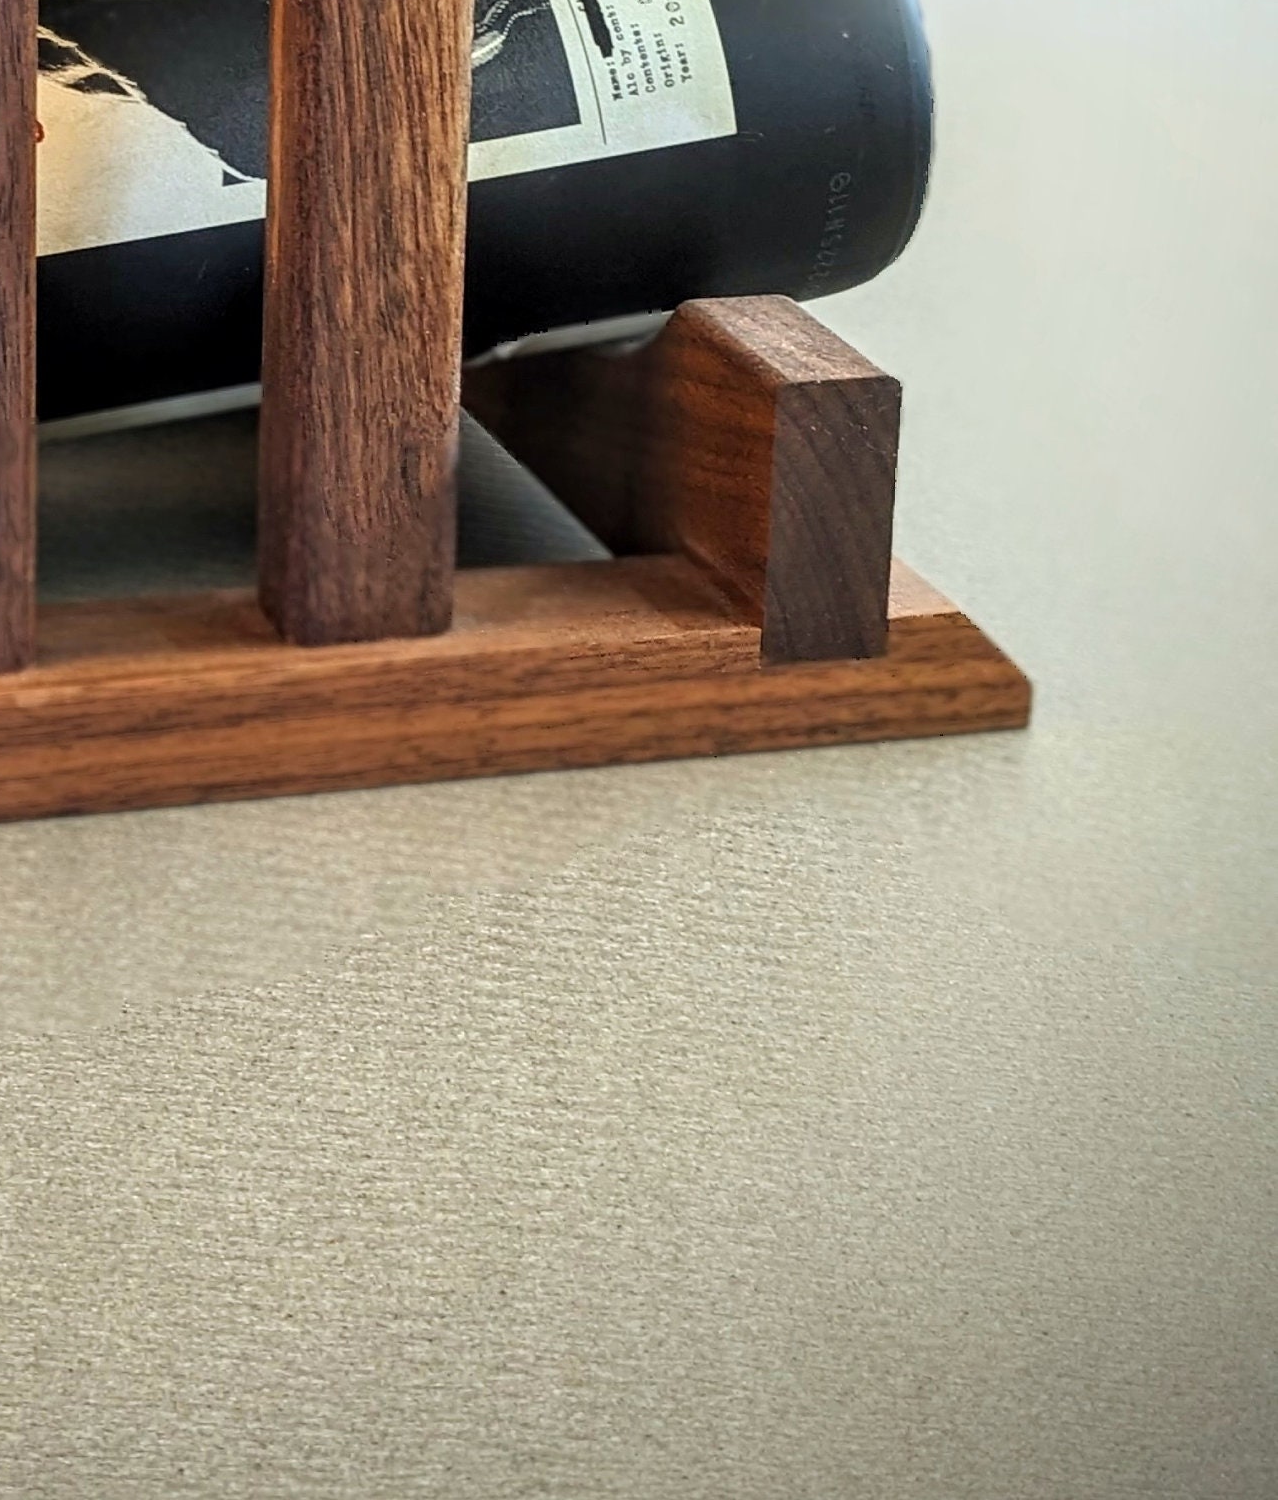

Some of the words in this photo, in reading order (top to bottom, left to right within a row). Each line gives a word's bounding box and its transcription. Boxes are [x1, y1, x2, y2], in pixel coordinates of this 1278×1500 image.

[620, 49, 632, 67] by
[630, 23, 656, 93] Contents:
[654, 32, 675, 88] Origin:
[675, 42, 692, 84] Year:
[606, 61, 623, 101] Name:
[627, 72, 639, 96] Alc
